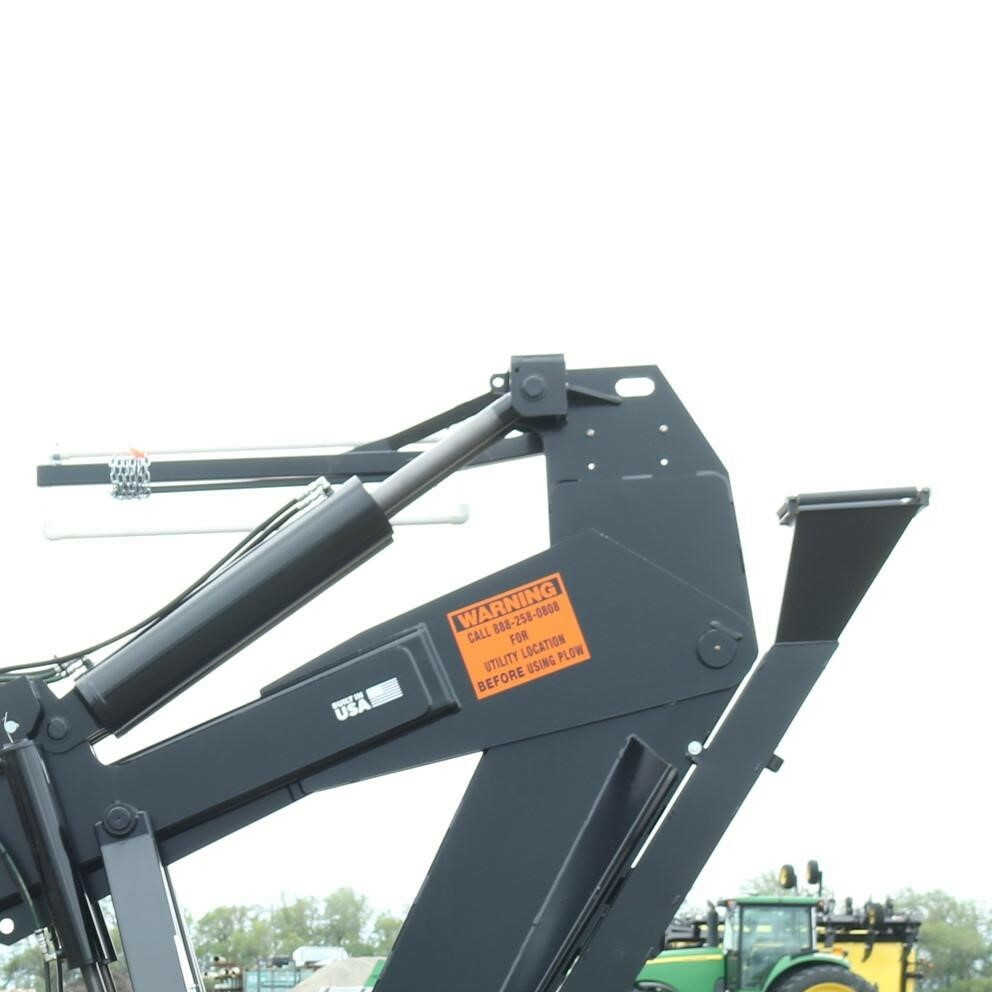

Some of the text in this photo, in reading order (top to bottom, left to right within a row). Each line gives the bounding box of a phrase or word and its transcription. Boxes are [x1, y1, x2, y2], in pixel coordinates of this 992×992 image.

[457, 580, 557, 629] WARNING
[467, 601, 560, 644] CALL 888-258-0808
[484, 634, 566, 672] UTILITY LOCATION
[510, 630, 529, 645] FOR
[477, 645, 584, 692] BEFORE USING PLOW
[334, 698, 372, 721] USA
